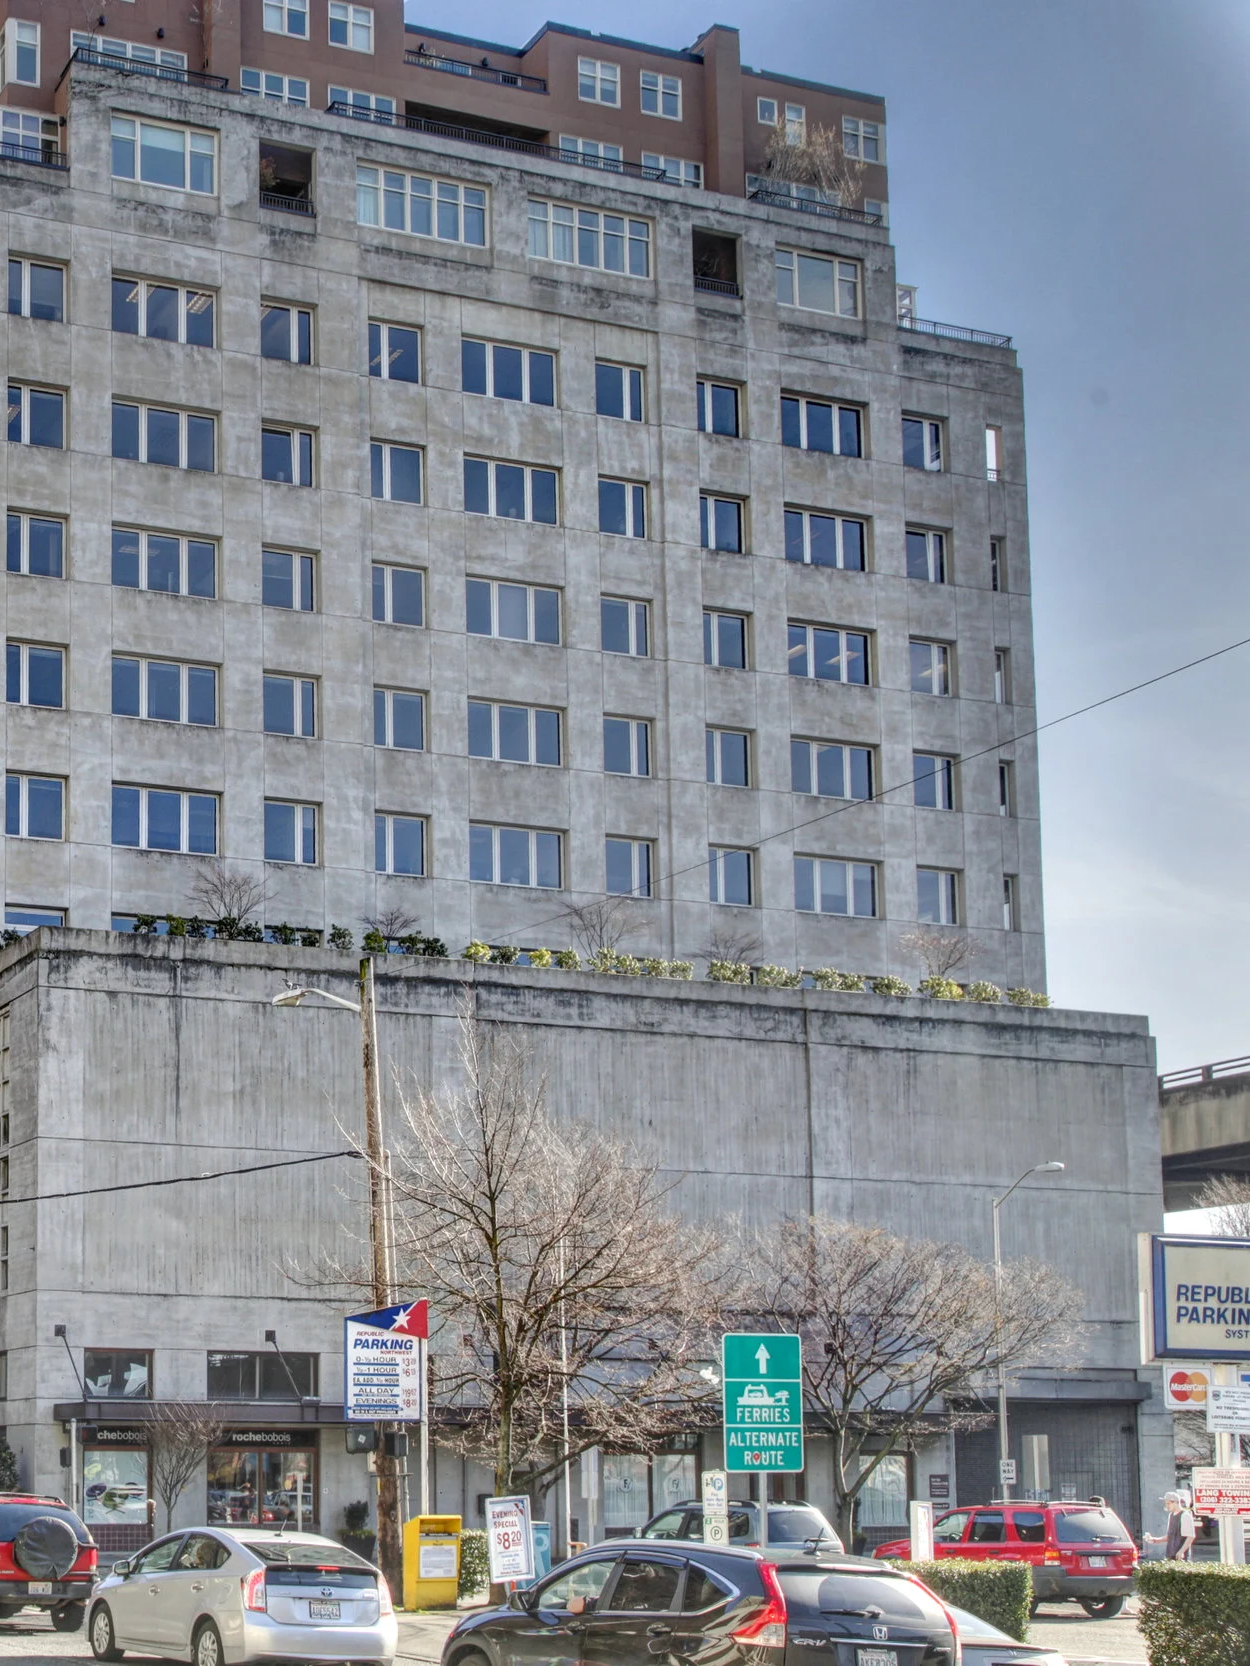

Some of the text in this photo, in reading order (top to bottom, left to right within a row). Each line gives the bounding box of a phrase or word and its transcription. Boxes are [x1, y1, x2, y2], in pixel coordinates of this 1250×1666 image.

[1176, 1306, 1250, 1325] PARKIN
[353, 1338, 414, 1350] PARKING
[736, 1408, 791, 1423] FERRIES
[232, 1431, 291, 1442] rochebobois
[729, 1432, 799, 1447] ALTERNATE
[744, 1451, 784, 1466] ROUTE
[492, 1510, 519, 1519] EVENING
[494, 1520, 517, 1529] SPECIAL
